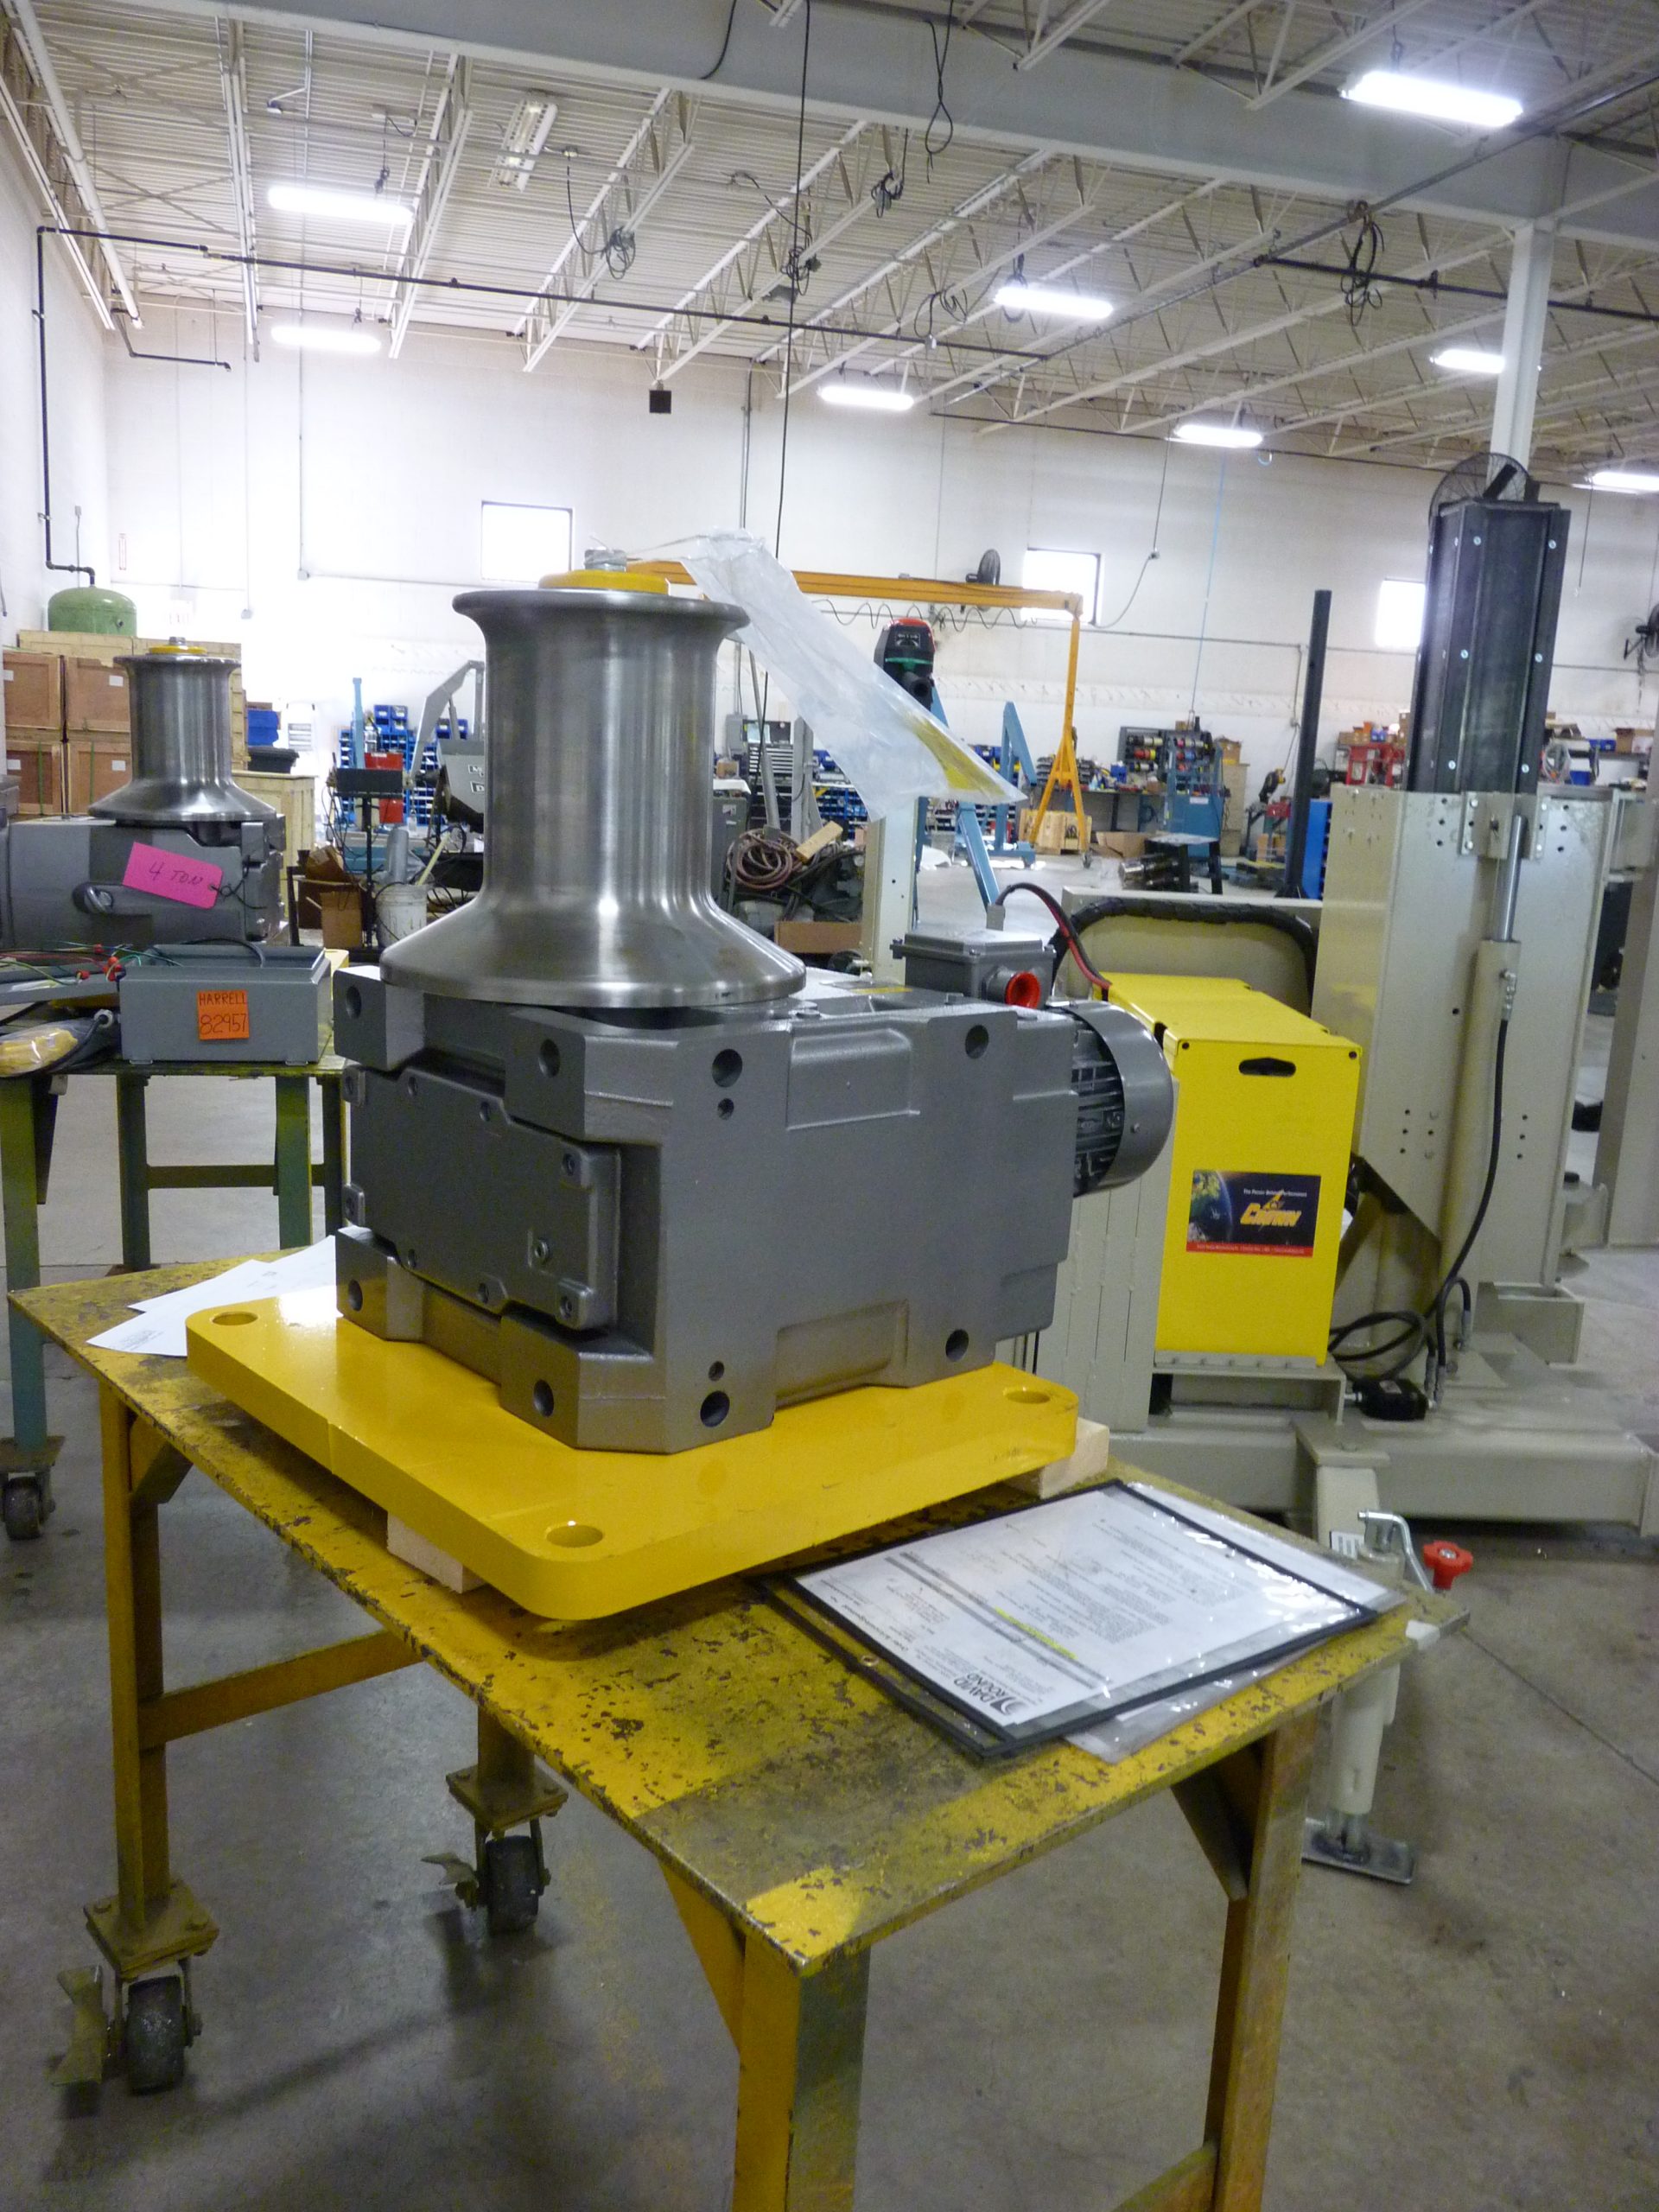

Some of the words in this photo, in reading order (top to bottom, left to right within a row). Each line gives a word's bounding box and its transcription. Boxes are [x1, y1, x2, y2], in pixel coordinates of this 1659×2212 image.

[149, 861, 164, 880] 4
[199, 992, 245, 1006] HARRELL
[200, 1013, 247, 1035] 82957
[953, 1677, 996, 1702] DAVID
